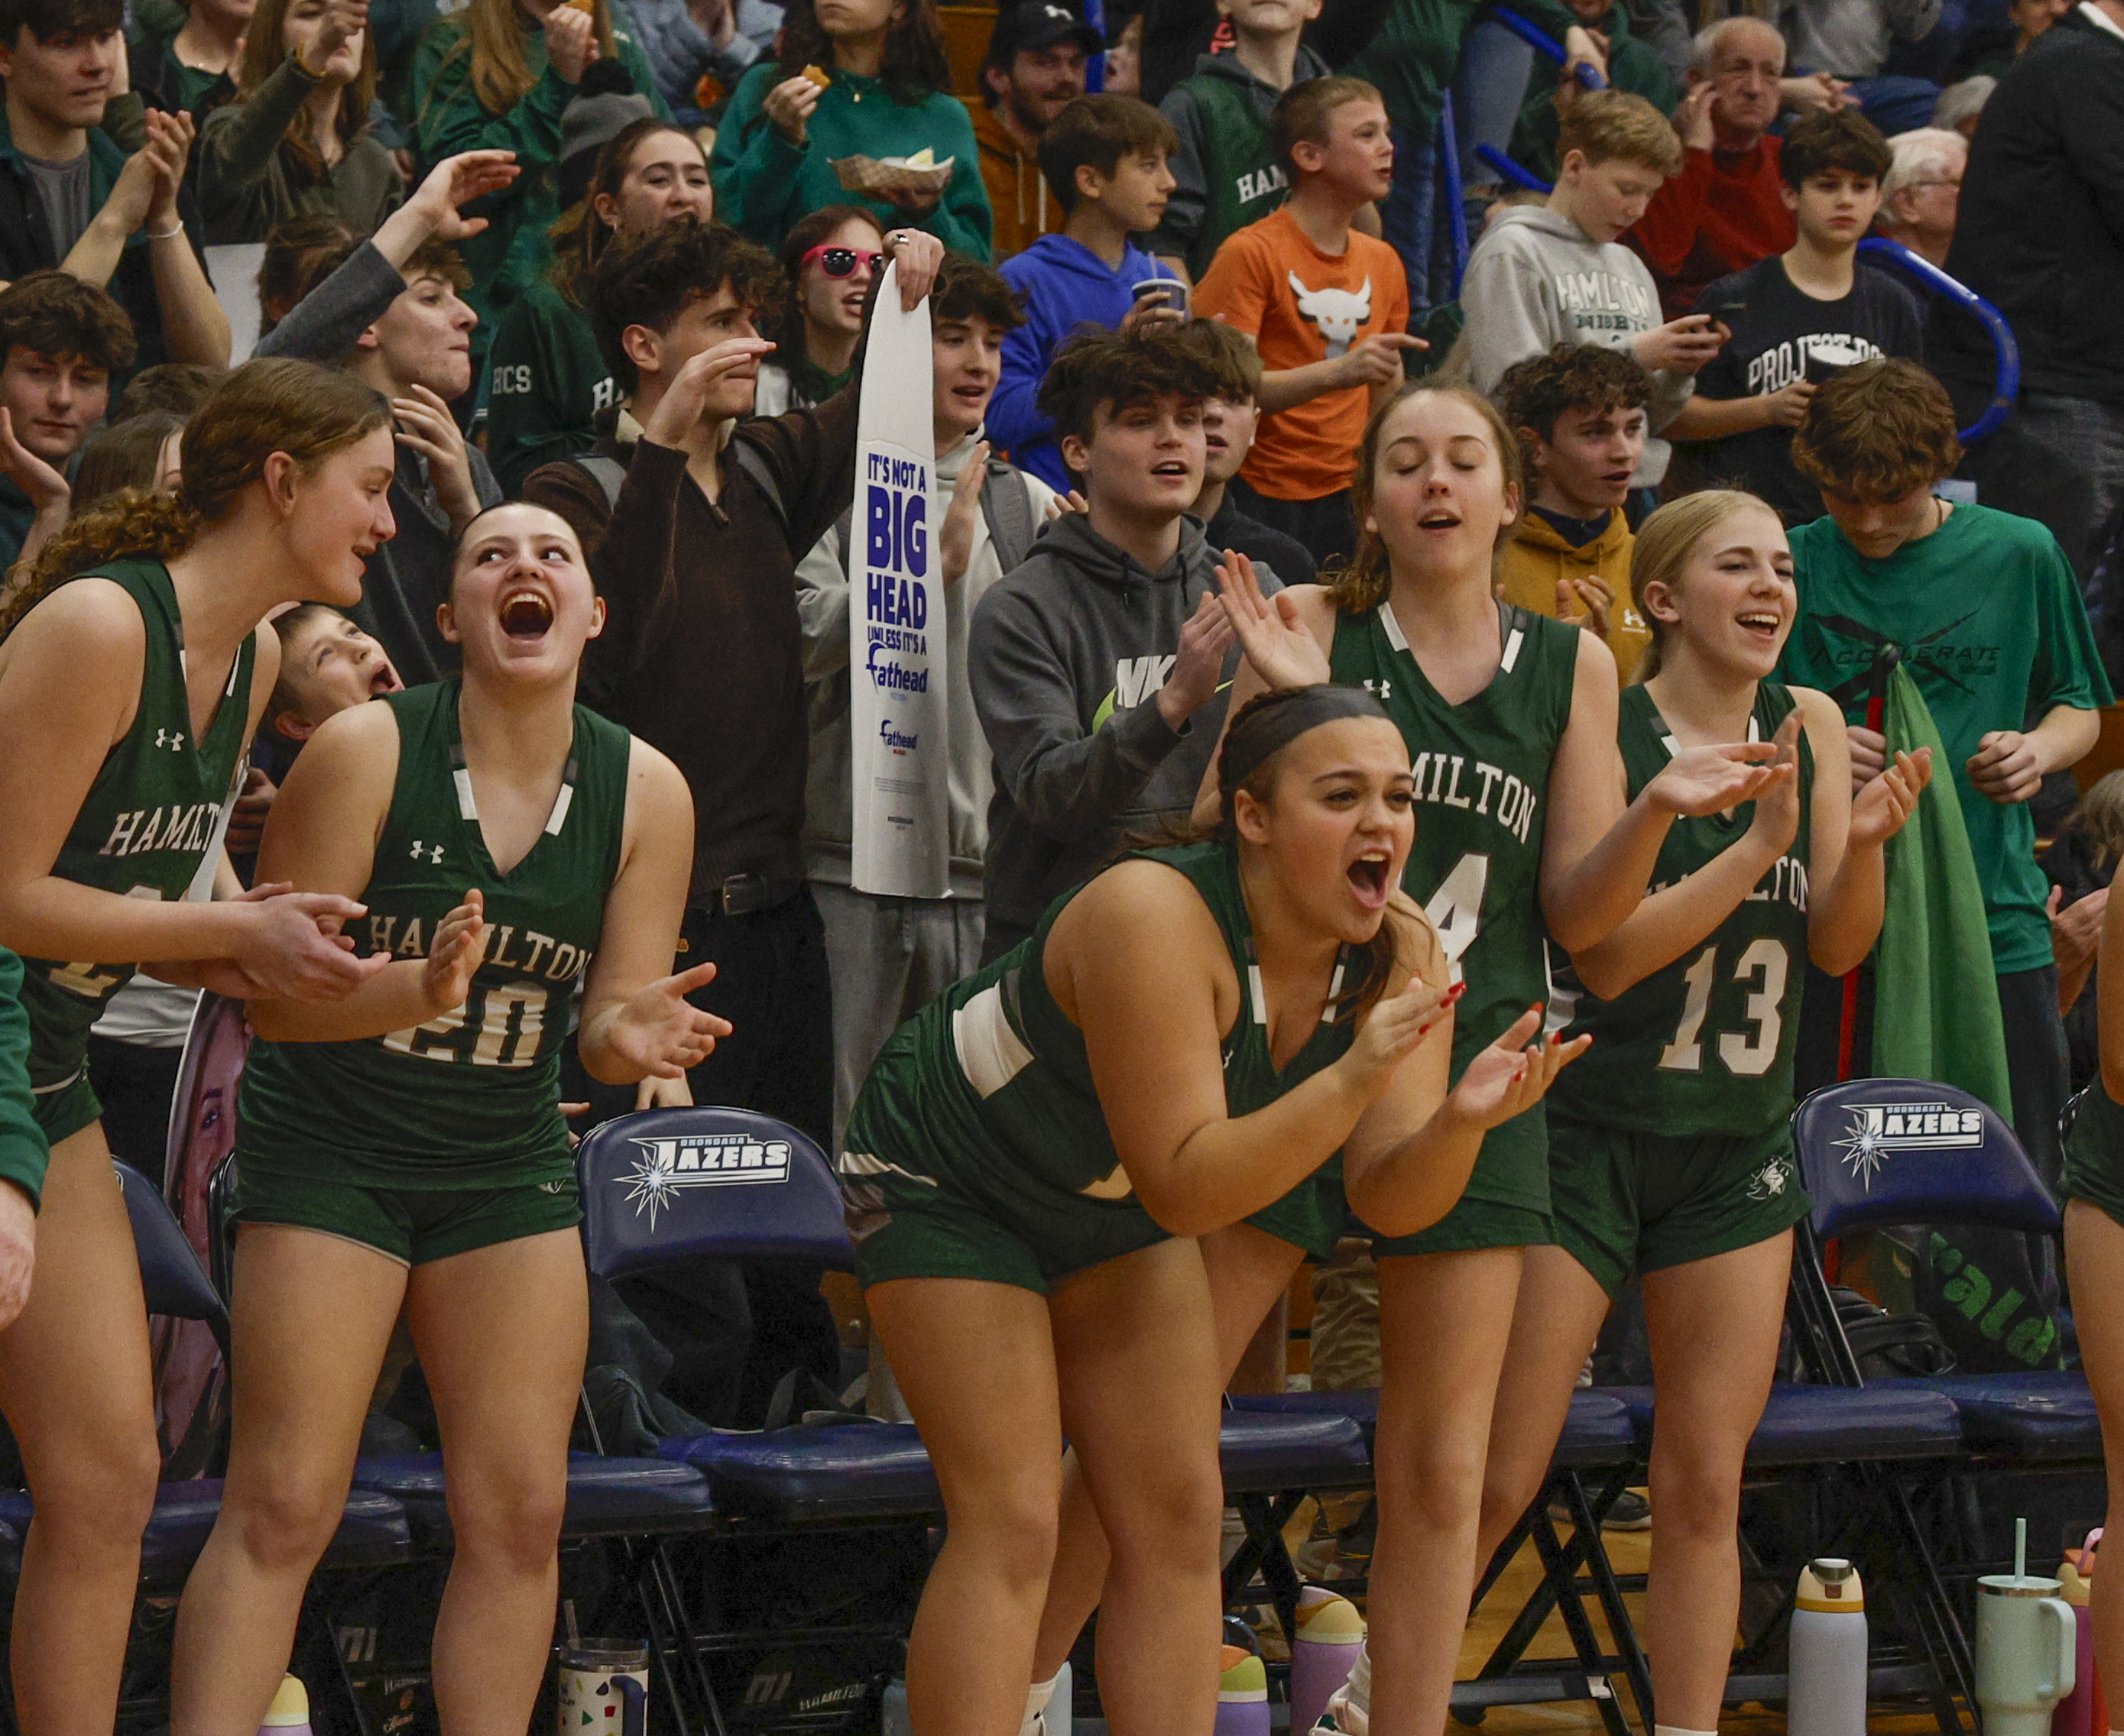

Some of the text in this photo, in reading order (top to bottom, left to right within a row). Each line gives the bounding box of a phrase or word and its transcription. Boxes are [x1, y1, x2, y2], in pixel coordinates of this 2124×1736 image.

[1748, 333, 1851, 396] PROJ
[868, 453, 926, 493] IT'S NOT A
[867, 484, 927, 578] BIG
[867, 572, 926, 630] HEAD
[867, 625, 927, 656] UNLESS IT'S A
[1117, 654, 1177, 708] NIK
[98, 802, 221, 857] HAMILT
[1398, 853, 1489, 986] 4
[371, 916, 593, 981] HAILTON
[1656, 938, 1789, 1075] 13
[1863, 1109, 1980, 1146] LAZERS
[653, 1142, 788, 1182] LAZERS
